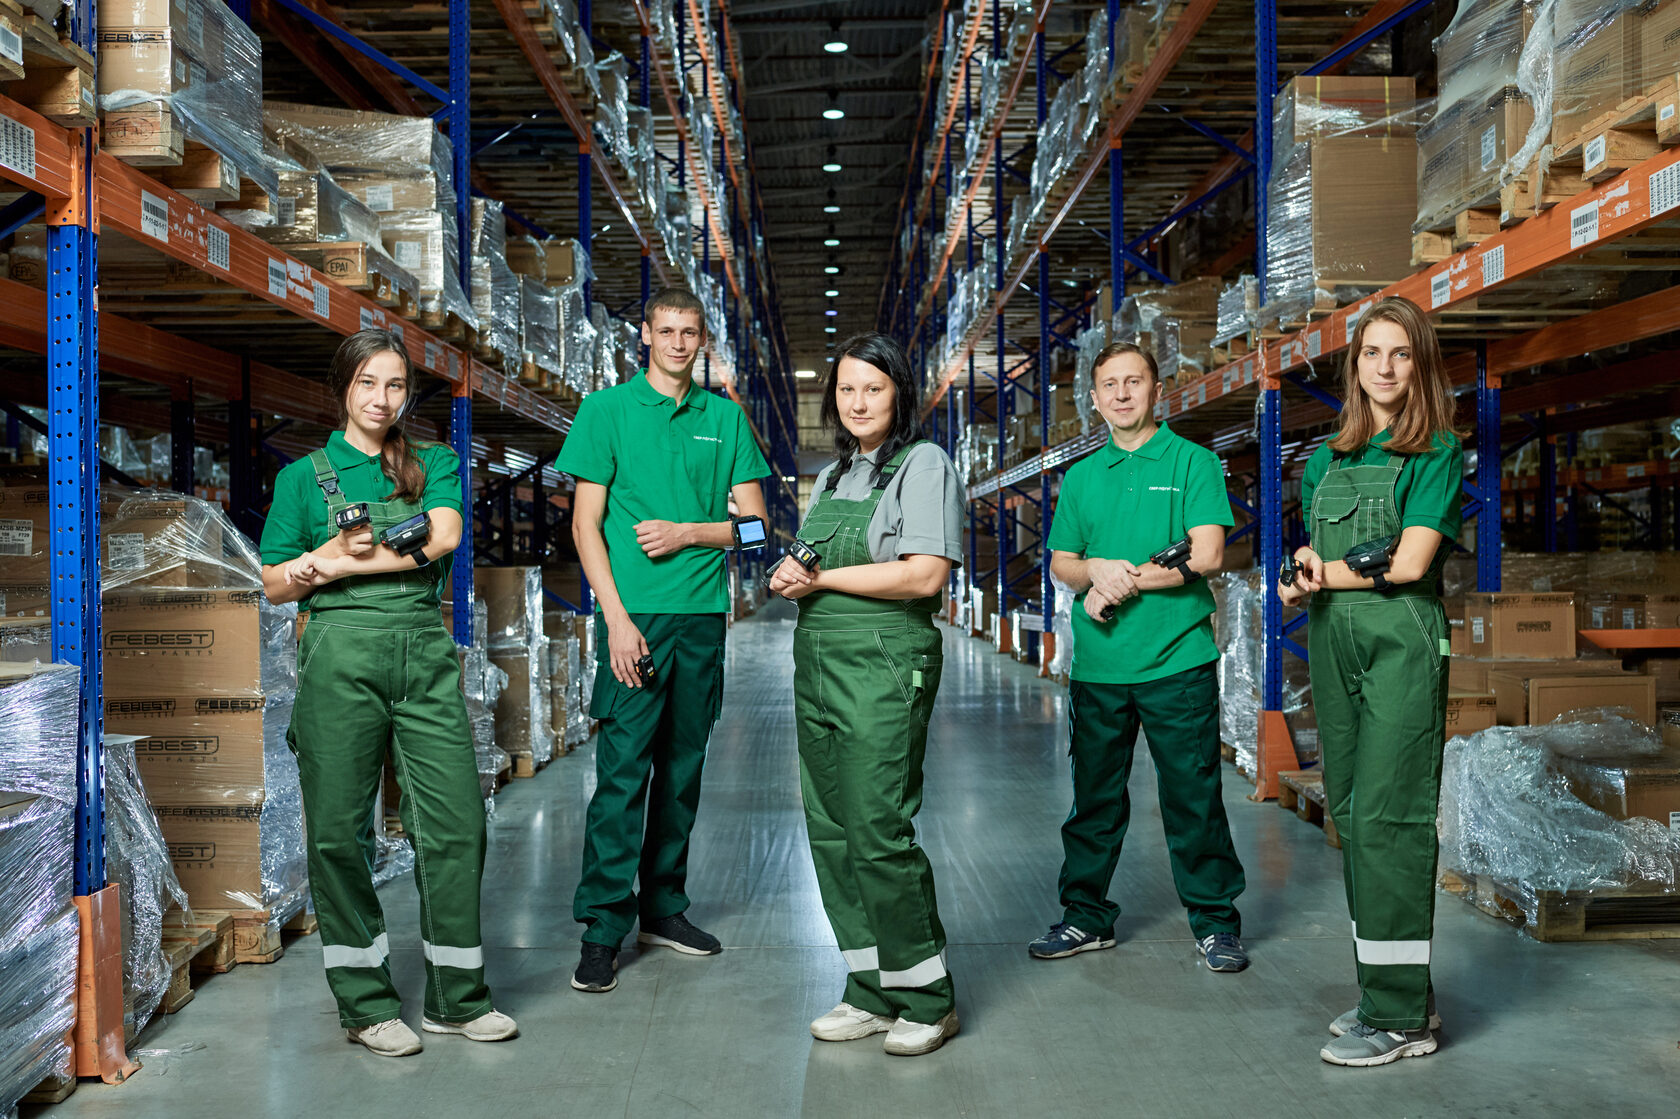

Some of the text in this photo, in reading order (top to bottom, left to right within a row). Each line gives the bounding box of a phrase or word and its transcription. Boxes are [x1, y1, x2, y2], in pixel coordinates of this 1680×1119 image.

[110, 634, 209, 646] FEBEST
[109, 700, 173, 712] FEBEST
[198, 699, 260, 710] FEBEST
[135, 740, 214, 751] EBEST
